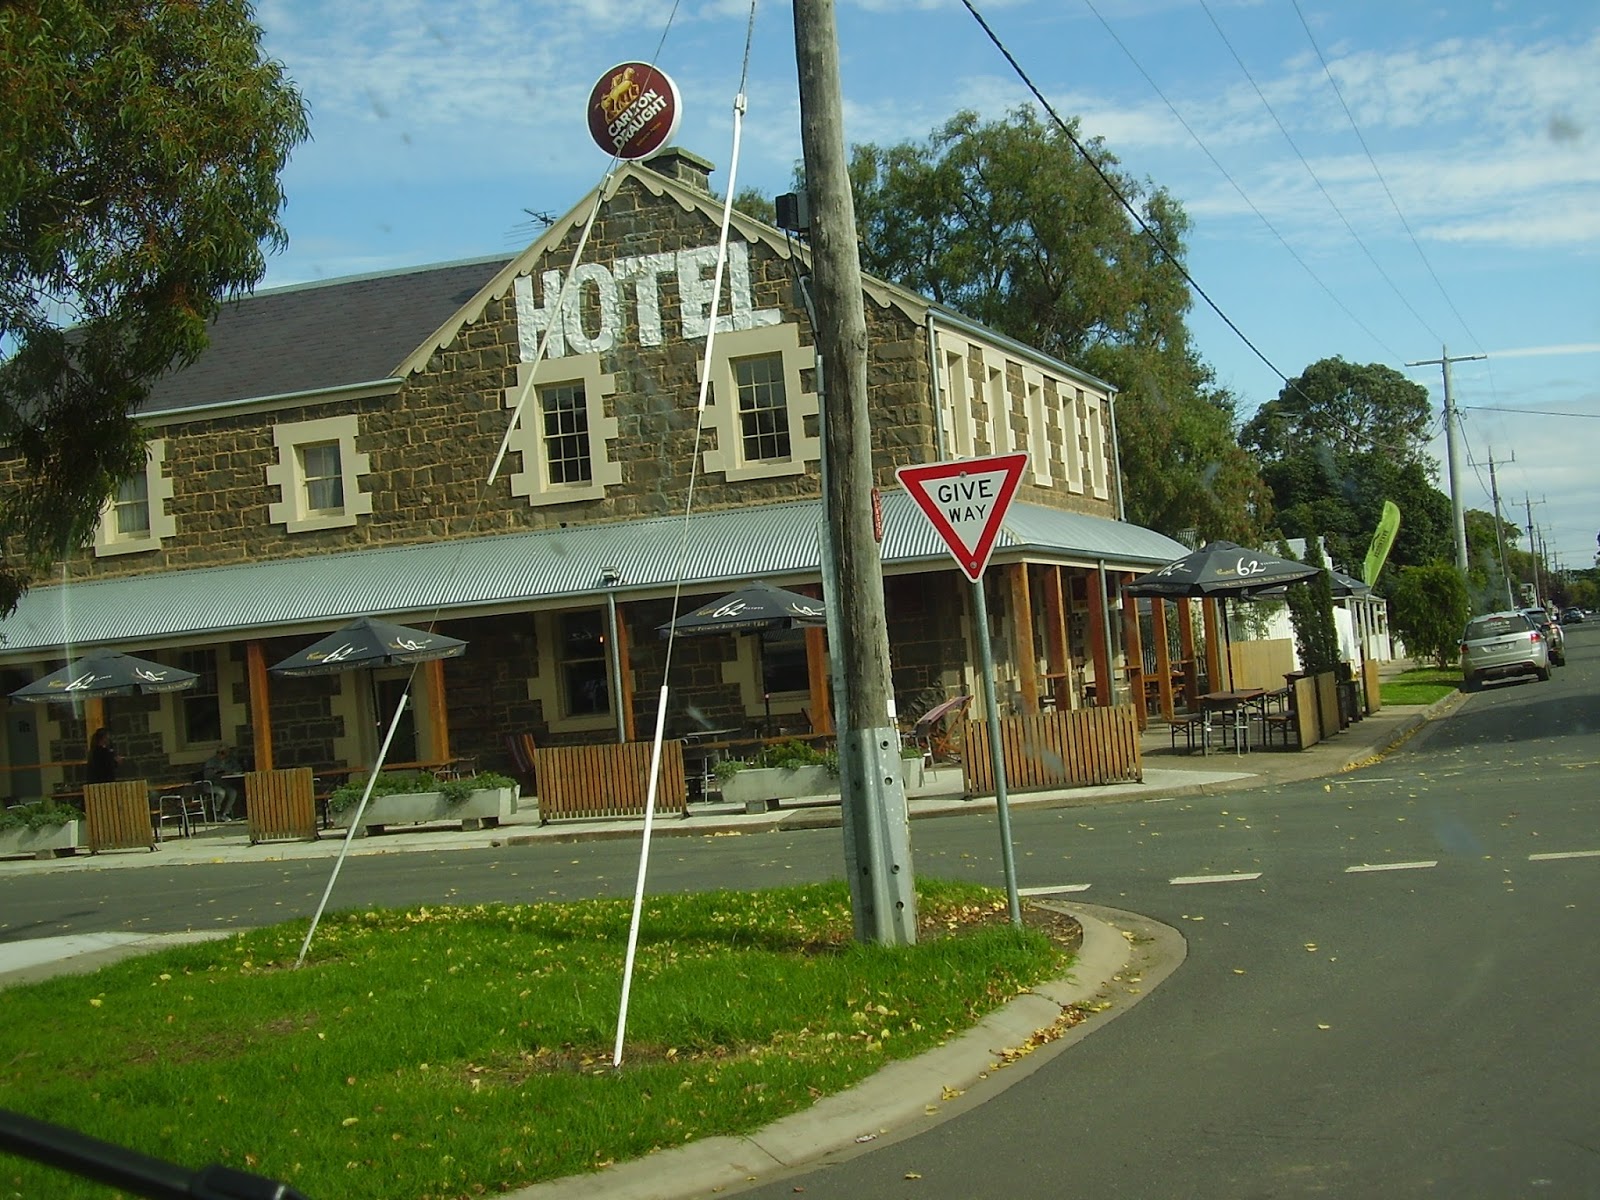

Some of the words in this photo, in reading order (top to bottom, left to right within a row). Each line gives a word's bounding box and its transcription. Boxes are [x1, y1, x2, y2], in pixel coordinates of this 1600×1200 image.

[608, 88, 657, 137] CARLTON
[612, 95, 667, 150] DRAUGHT
[514, 240, 782, 363] HOTEL
[938, 479, 993, 503] GIVE
[948, 504, 986, 523] WAY
[1236, 557, 1266, 576] 62
